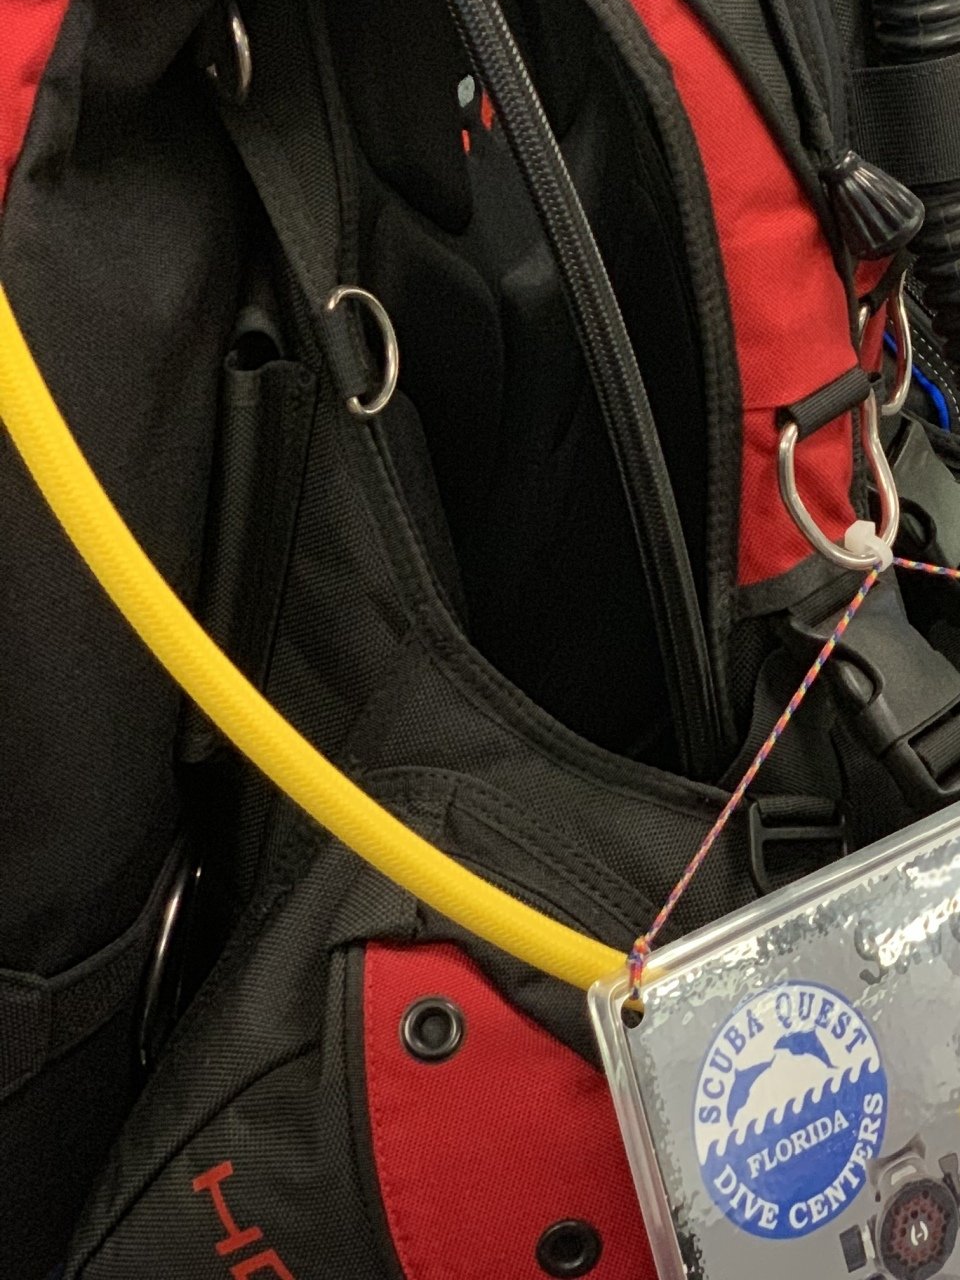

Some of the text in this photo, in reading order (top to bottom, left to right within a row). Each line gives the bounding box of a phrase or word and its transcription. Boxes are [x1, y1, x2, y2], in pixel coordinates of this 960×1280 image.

[698, 991, 868, 1125] SCUBA QUEST
[713, 1092, 885, 1231] DIVE CENTERS
[746, 1109, 850, 1179] FLORIDA
